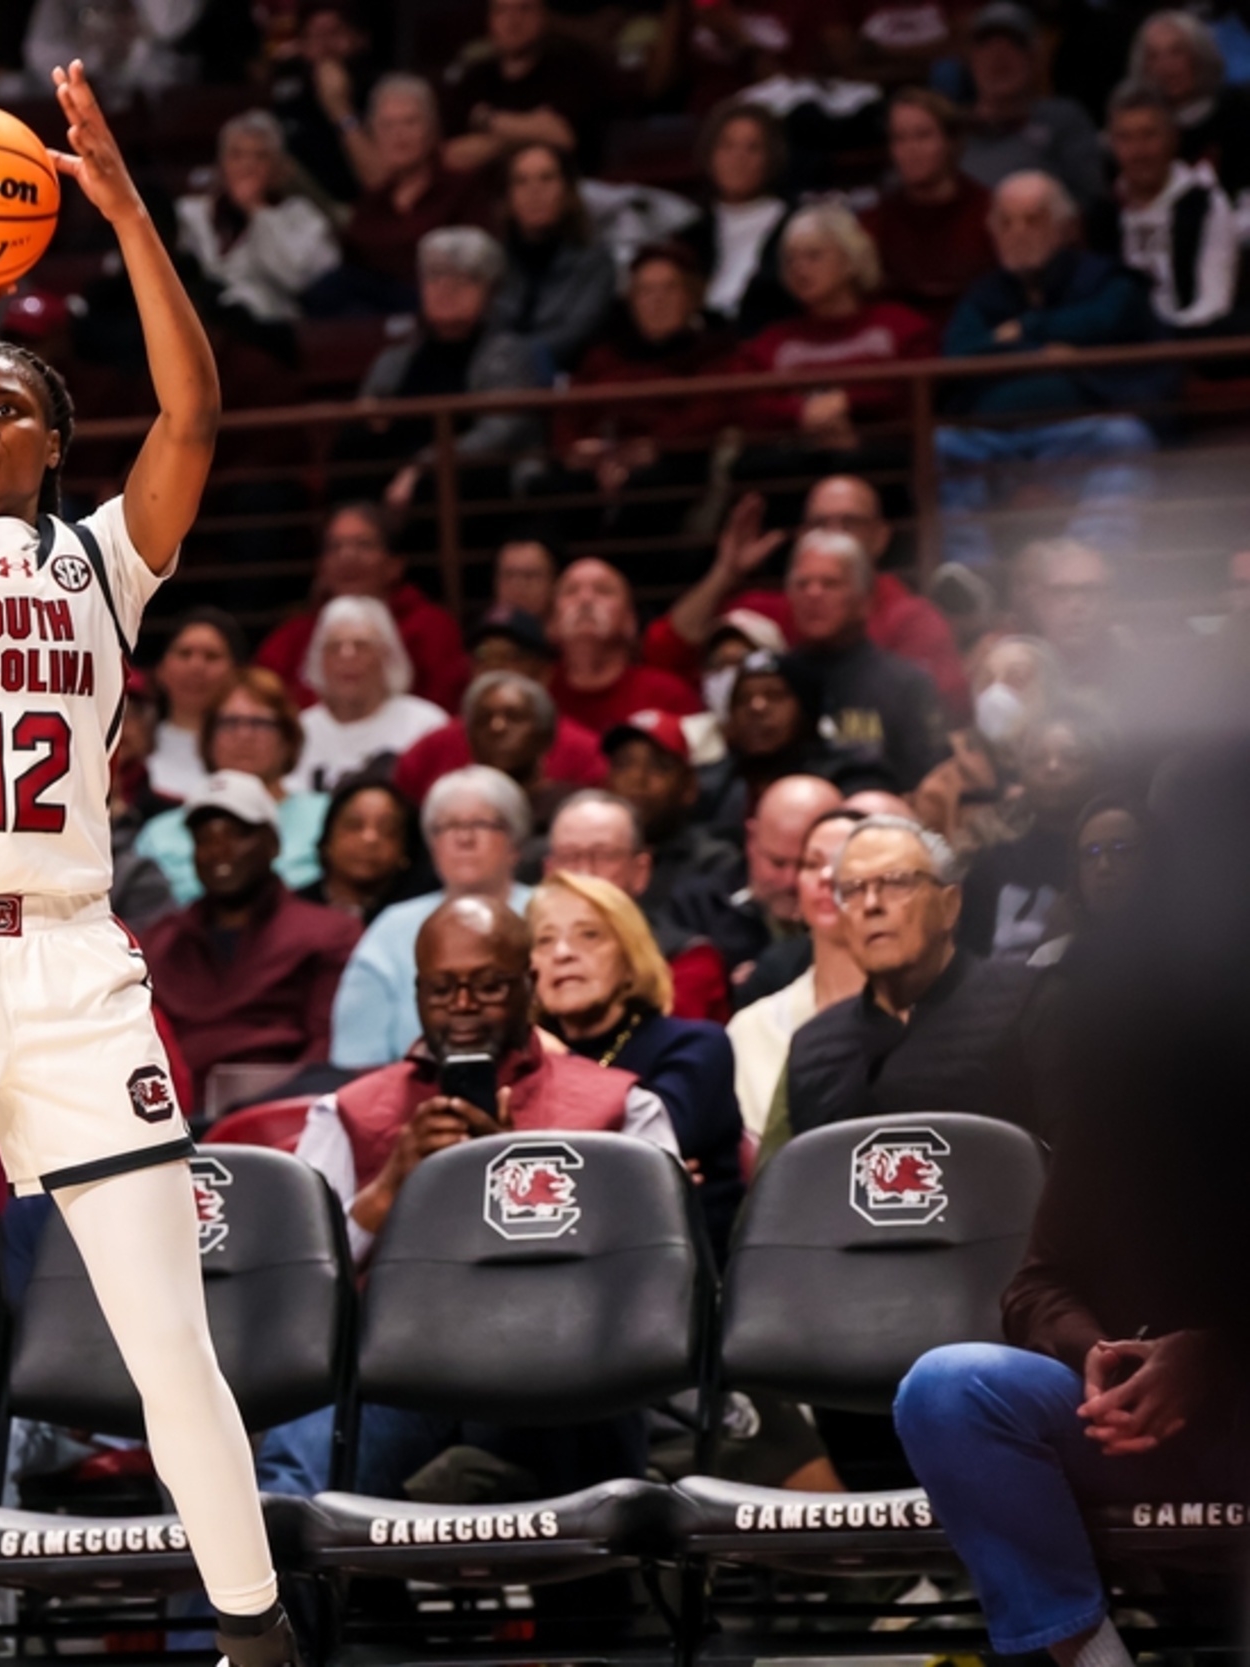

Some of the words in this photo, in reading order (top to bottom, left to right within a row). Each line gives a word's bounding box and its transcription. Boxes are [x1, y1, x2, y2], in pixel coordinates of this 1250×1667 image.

[54, 558, 89, 590] SEC
[370, 1511, 559, 1545] GAMECOCKS
[733, 1500, 933, 1530] GAMECOCKS
[1133, 1502, 1250, 1527] GAMEC
[0, 1523, 187, 1557] GAMECOCKS
